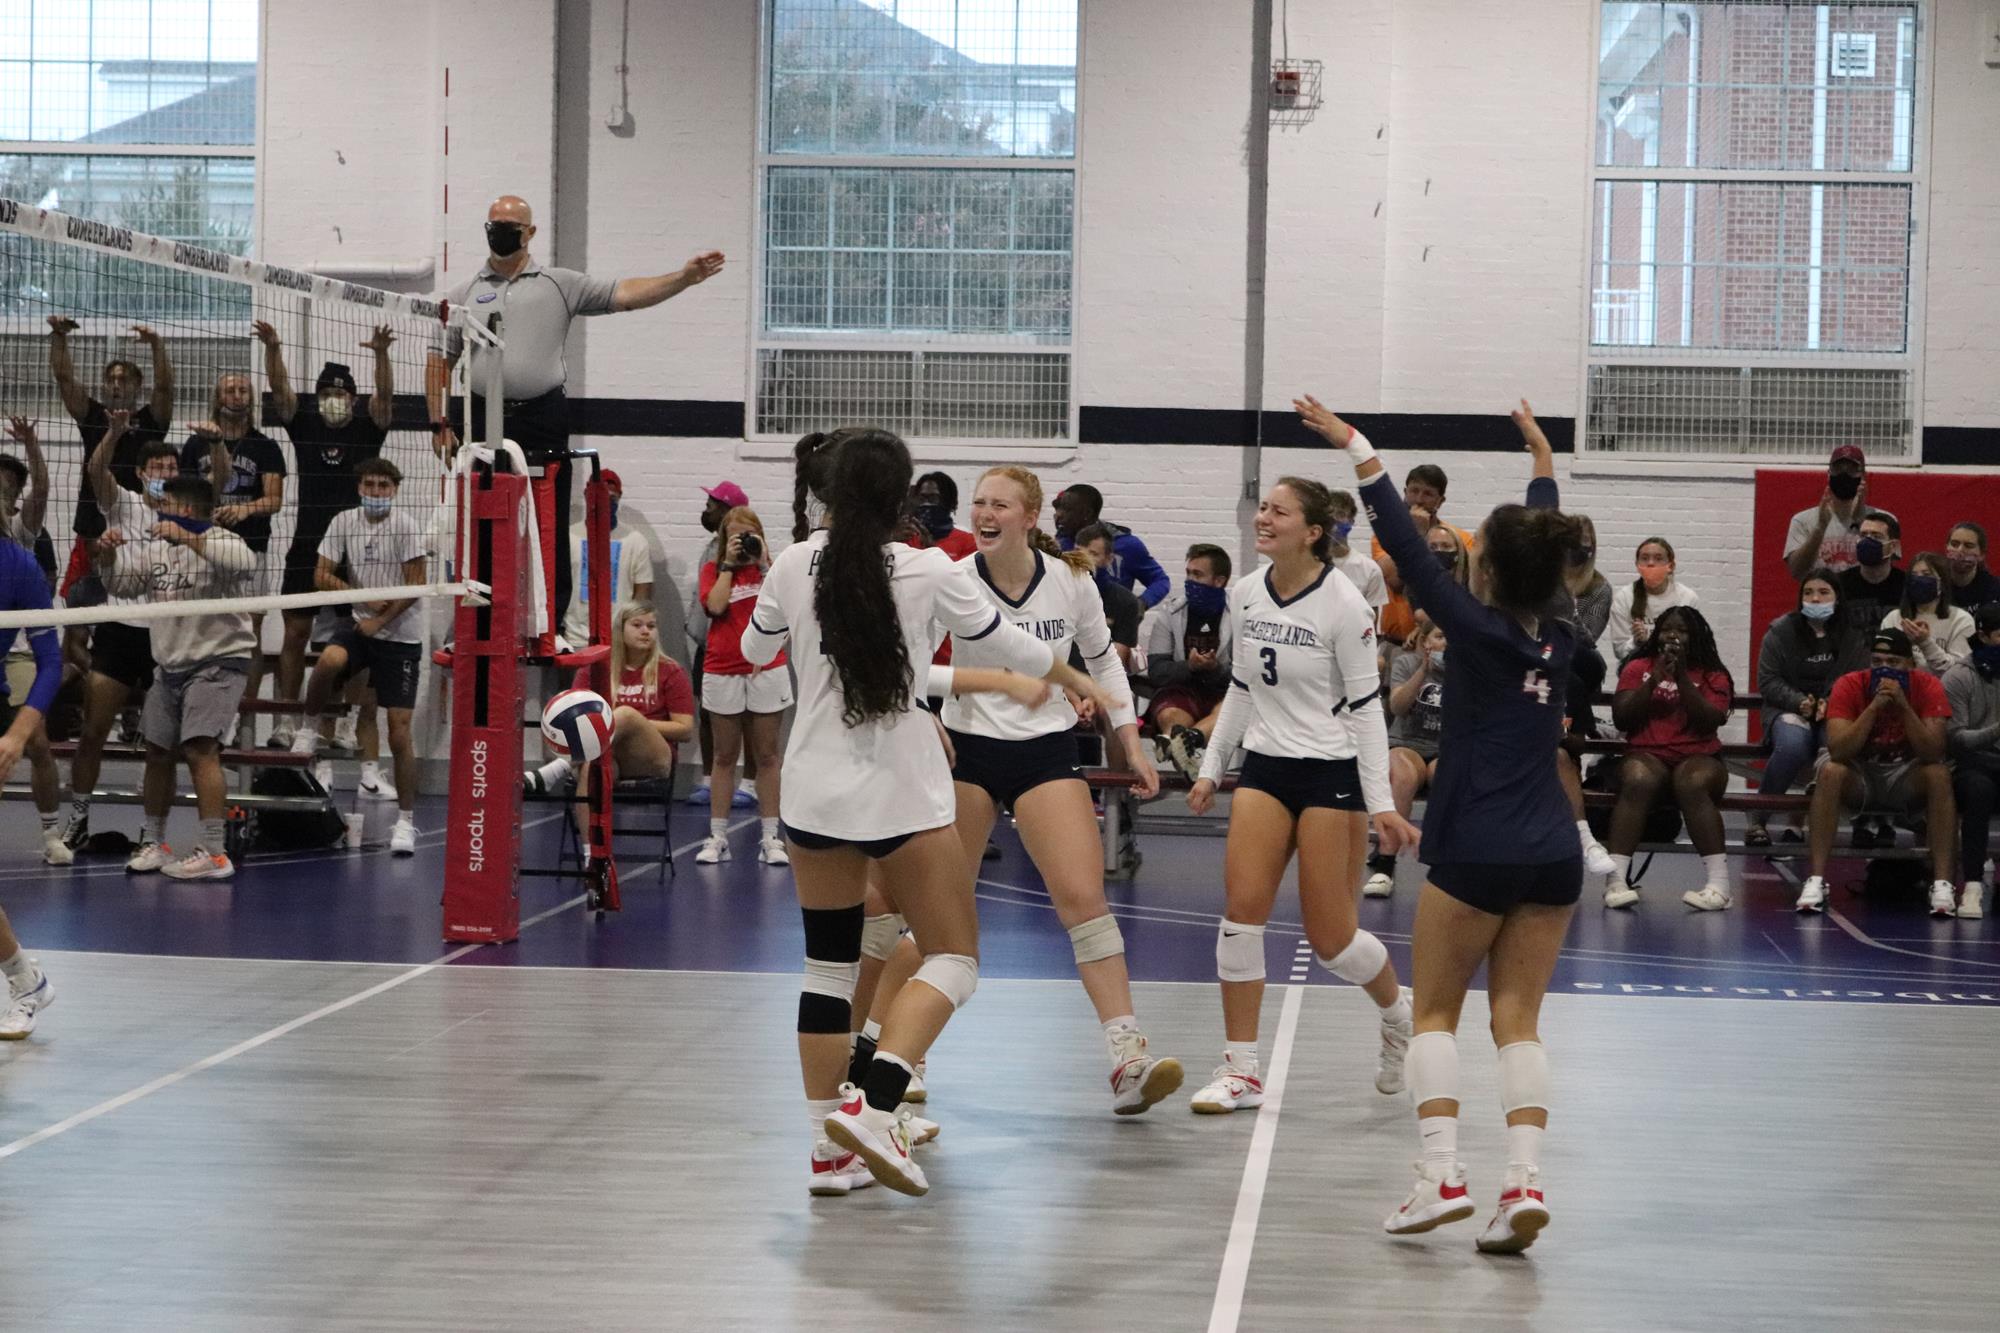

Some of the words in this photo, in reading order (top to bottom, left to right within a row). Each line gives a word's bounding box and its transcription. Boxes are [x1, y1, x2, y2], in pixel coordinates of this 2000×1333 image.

[67, 216, 133, 251] CUMBERLANDS
[1260, 647, 1278, 686] 3
[1523, 669, 1551, 704] 4
[470, 740, 487, 799] sports
